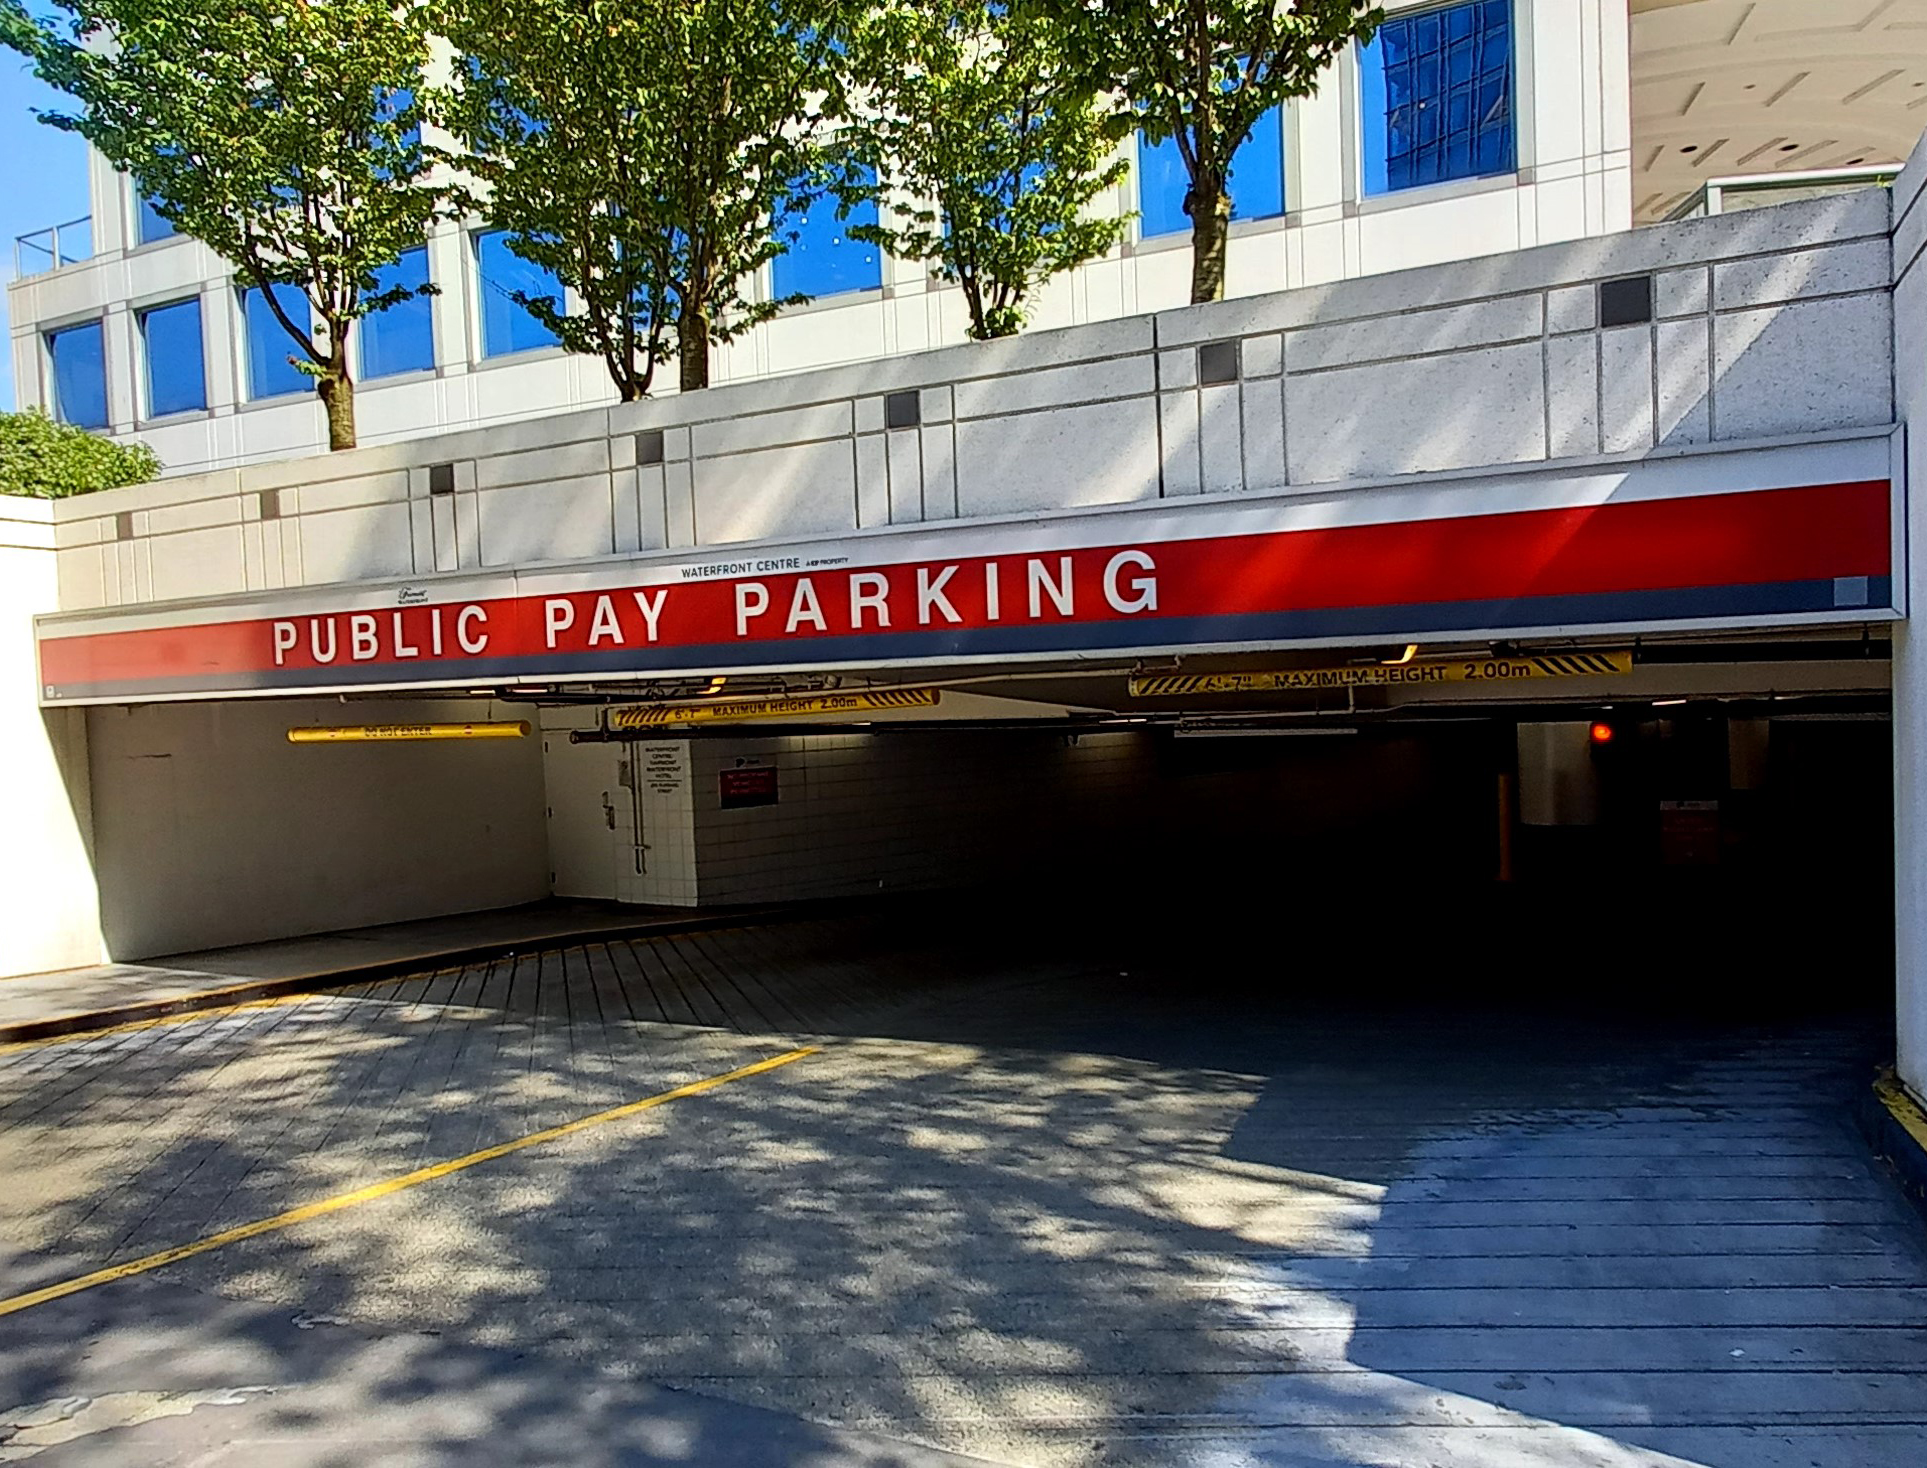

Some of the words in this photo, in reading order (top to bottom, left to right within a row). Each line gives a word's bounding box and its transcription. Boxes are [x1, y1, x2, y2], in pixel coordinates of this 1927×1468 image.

[682, 562, 752, 578] WATERFRONT
[756, 558, 801, 572] CENTRE
[273, 605, 489, 666] PUBLIC
[545, 590, 669, 649] PAY
[735, 549, 1161, 637] PARKING
[1274, 669, 1370, 687] MAXIMUM
[1376, 665, 1446, 683] HEIGHT
[1463, 661, 1532, 680] 2.00m
[711, 702, 768, 718] MAXIMUM
[770, 699, 814, 713] HEIGHT
[820, 696, 858, 710] 2.00m
